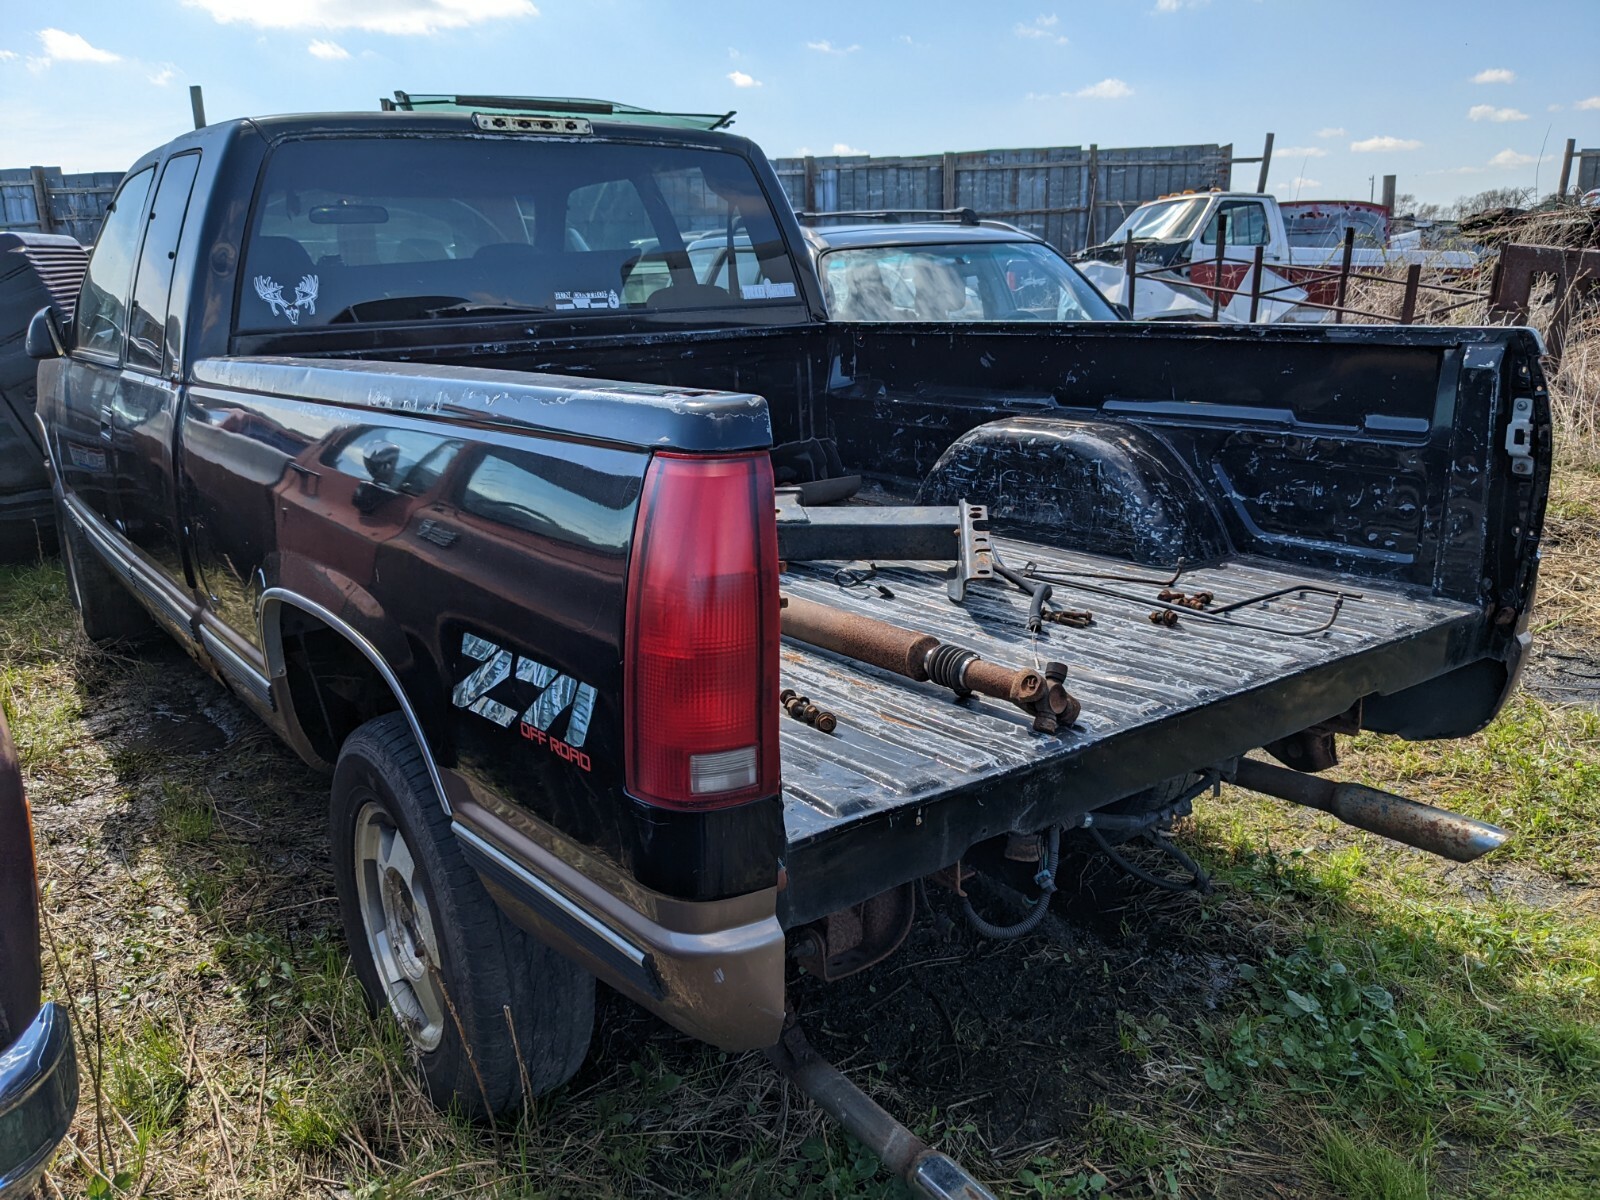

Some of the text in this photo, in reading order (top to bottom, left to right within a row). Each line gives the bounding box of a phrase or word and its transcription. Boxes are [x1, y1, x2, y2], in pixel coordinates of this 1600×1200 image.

[452, 632, 598, 748] Z71
[520, 721, 591, 772] OFF ROAD
